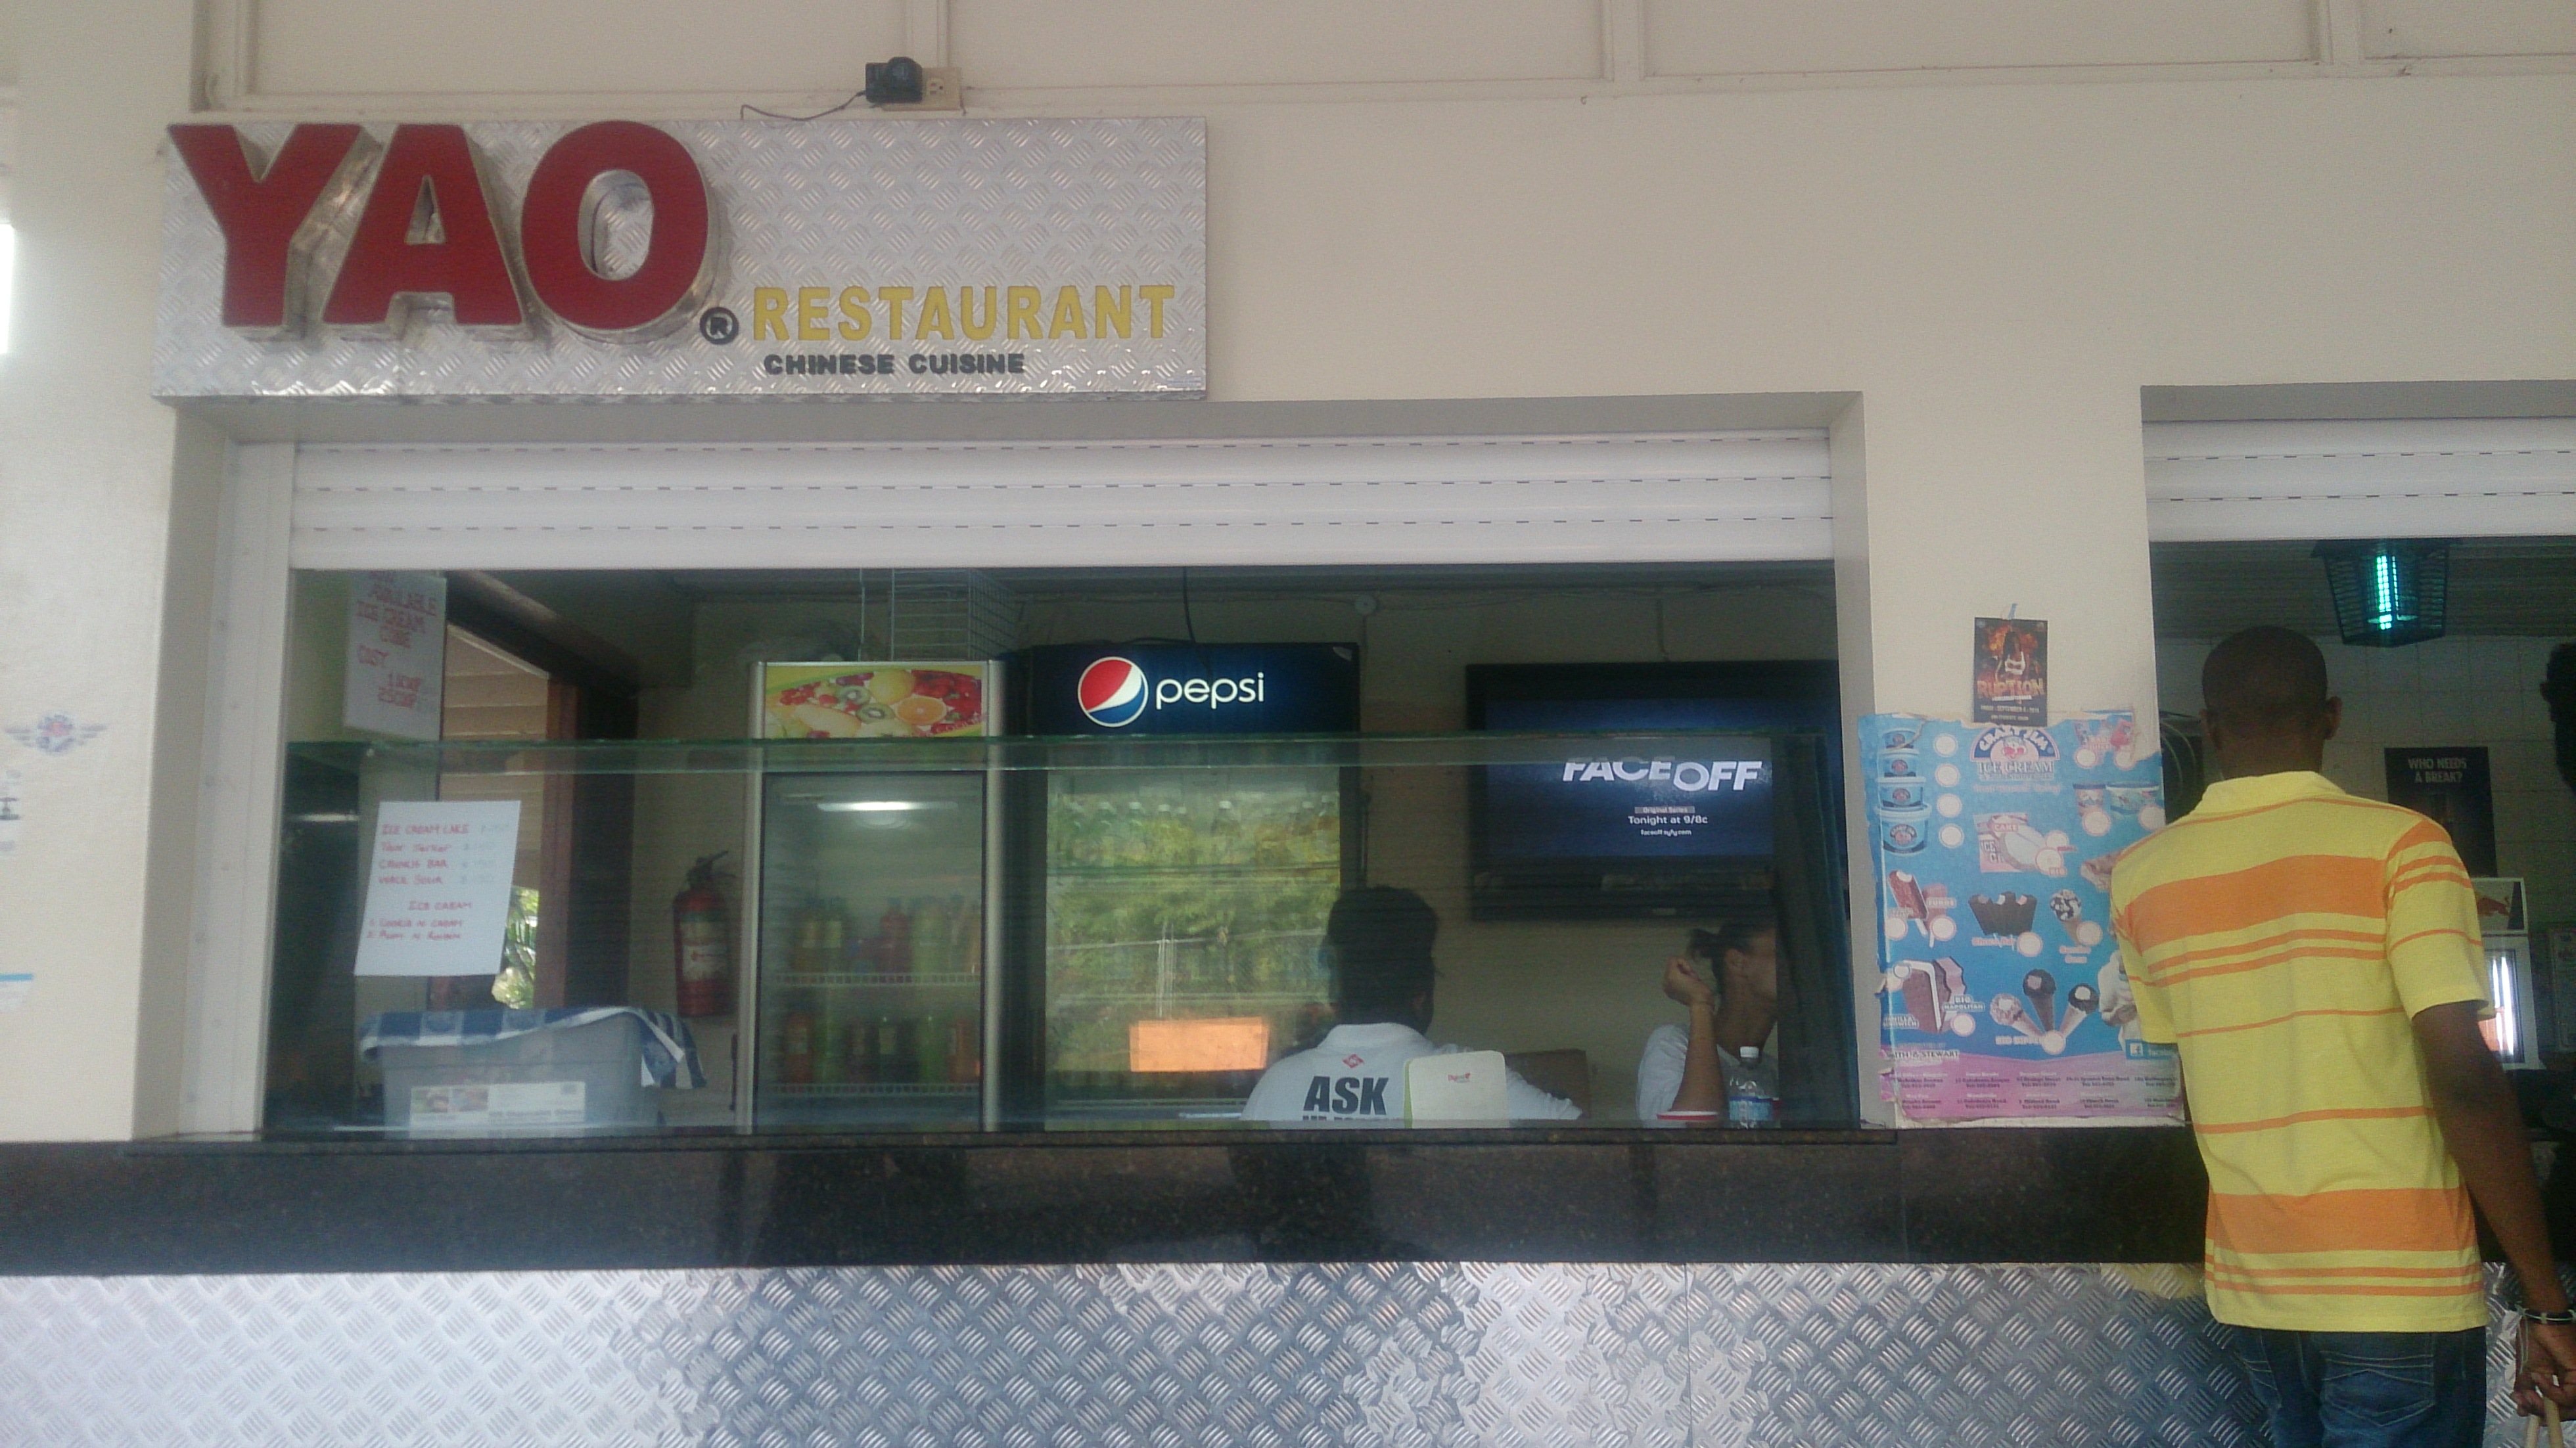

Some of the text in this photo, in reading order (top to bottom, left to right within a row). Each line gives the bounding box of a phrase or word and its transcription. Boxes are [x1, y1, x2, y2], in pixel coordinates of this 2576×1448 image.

[166, 120, 712, 328] YAO
[753, 285, 1175, 341] RESTAURANT
[764, 353, 1025, 374] CHINESE CUISINE
[1157, 672, 1266, 710] pepsi
[1979, 761, 2053, 774] ICE CREAM
[2408, 758, 2467, 769] WHO NEEDS
[2414, 771, 2423, 783] A
[1628, 815, 1667, 826] Tonight
[1684, 815, 1708, 825] 9/8c
[1303, 1075, 1389, 1115] ASK
